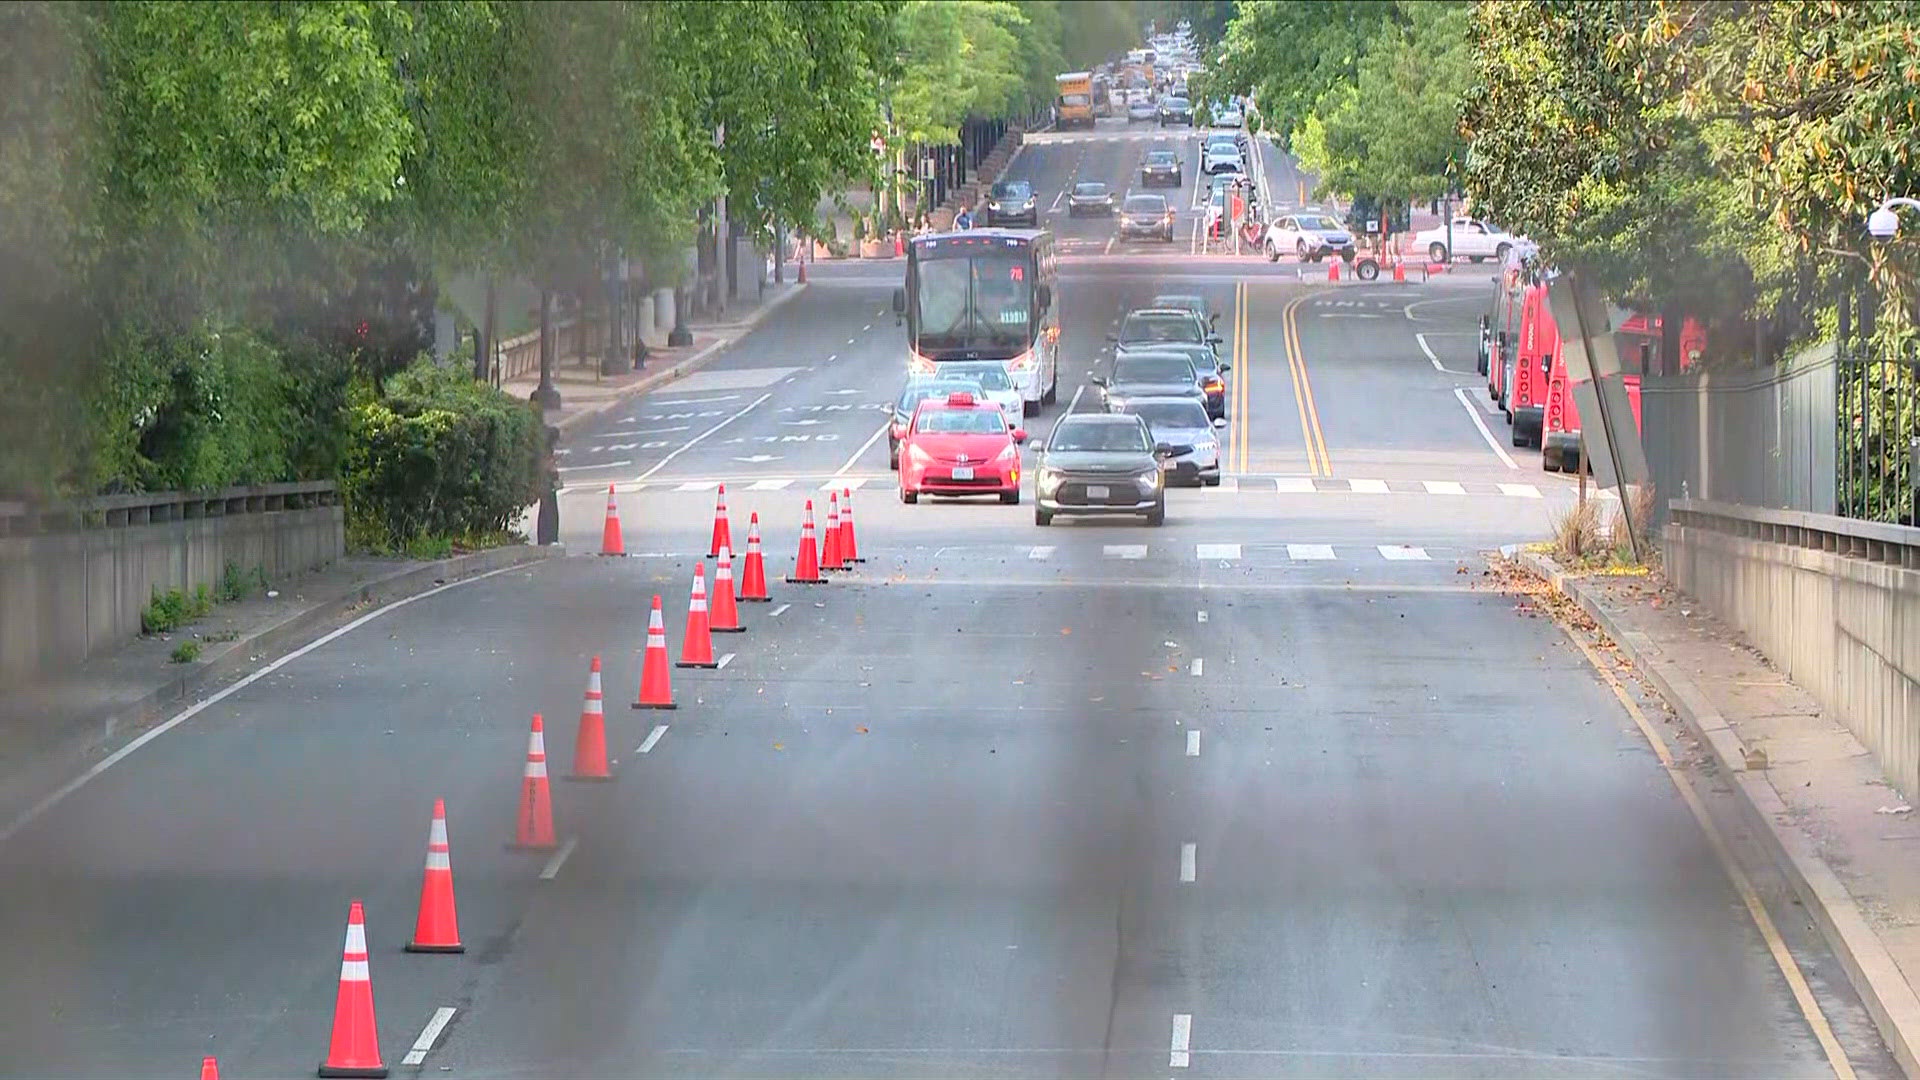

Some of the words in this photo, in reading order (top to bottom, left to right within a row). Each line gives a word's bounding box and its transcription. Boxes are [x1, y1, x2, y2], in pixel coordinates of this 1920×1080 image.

[777, 403, 882, 413] ONLY
[616, 411, 724, 424] ONLY
[723, 434, 839, 443] ONLY
